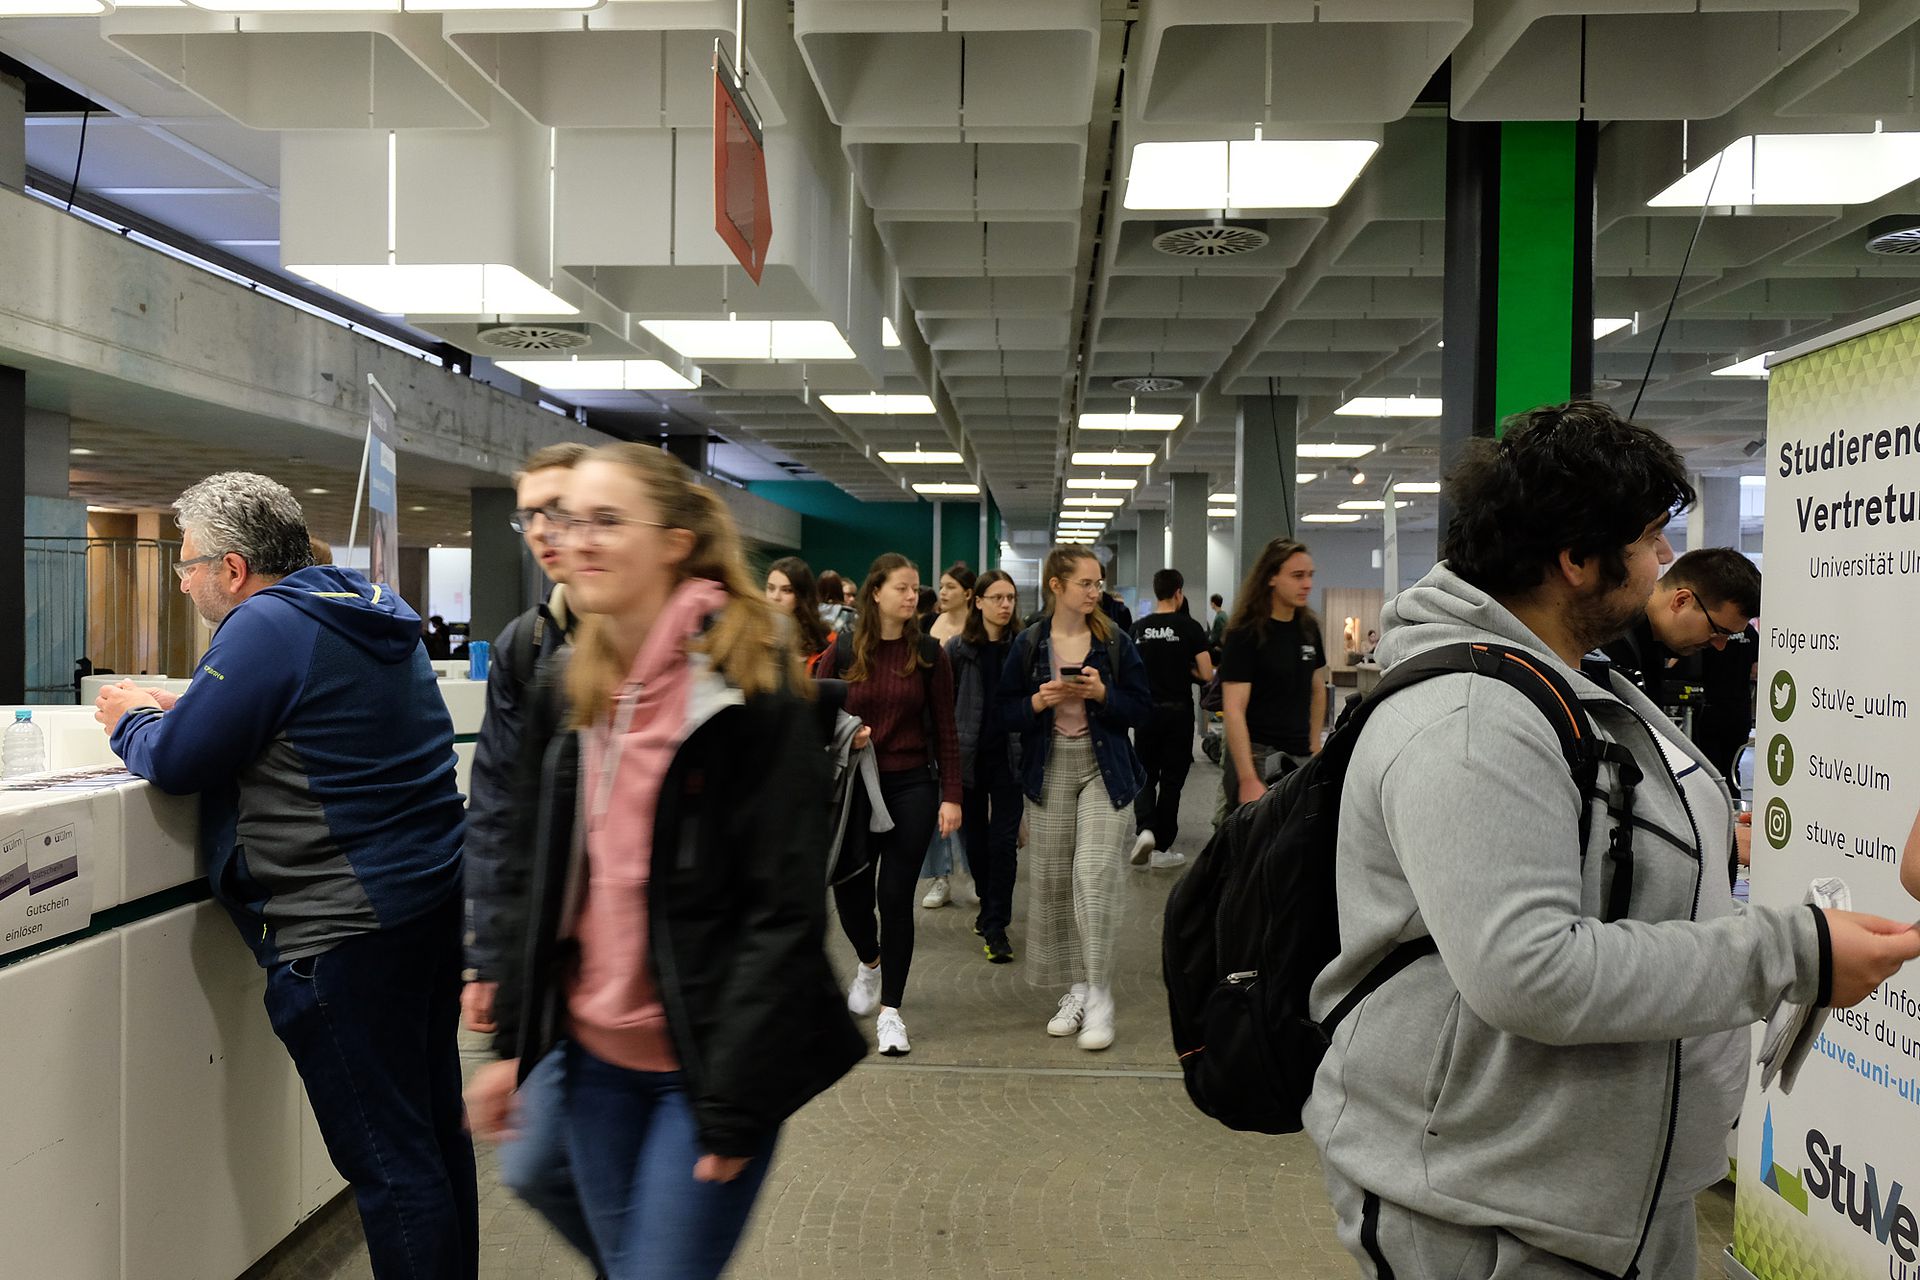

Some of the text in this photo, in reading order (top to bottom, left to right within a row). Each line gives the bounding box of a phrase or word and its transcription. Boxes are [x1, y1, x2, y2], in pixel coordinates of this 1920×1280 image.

[1796, 484, 1920, 532] Vertretu
[1810, 550, 1920, 578] Universität Ul
[1771, 628, 1840, 653] Folge uns:
[1812, 687, 1907, 719] StuVe_uulm
[1809, 755, 1890, 791] StuVe.Ulm
[1806, 821, 1897, 864] stuve_uulm
[26, 896, 69, 917] Gutschein
[5, 922, 43, 942] einlösen
[1884, 982, 1920, 1020] Info
[1875, 1020, 1896, 1048] du
[1812, 1032, 1920, 1106] stuve.uni-ul
[1803, 1129, 1919, 1262] StuVe
